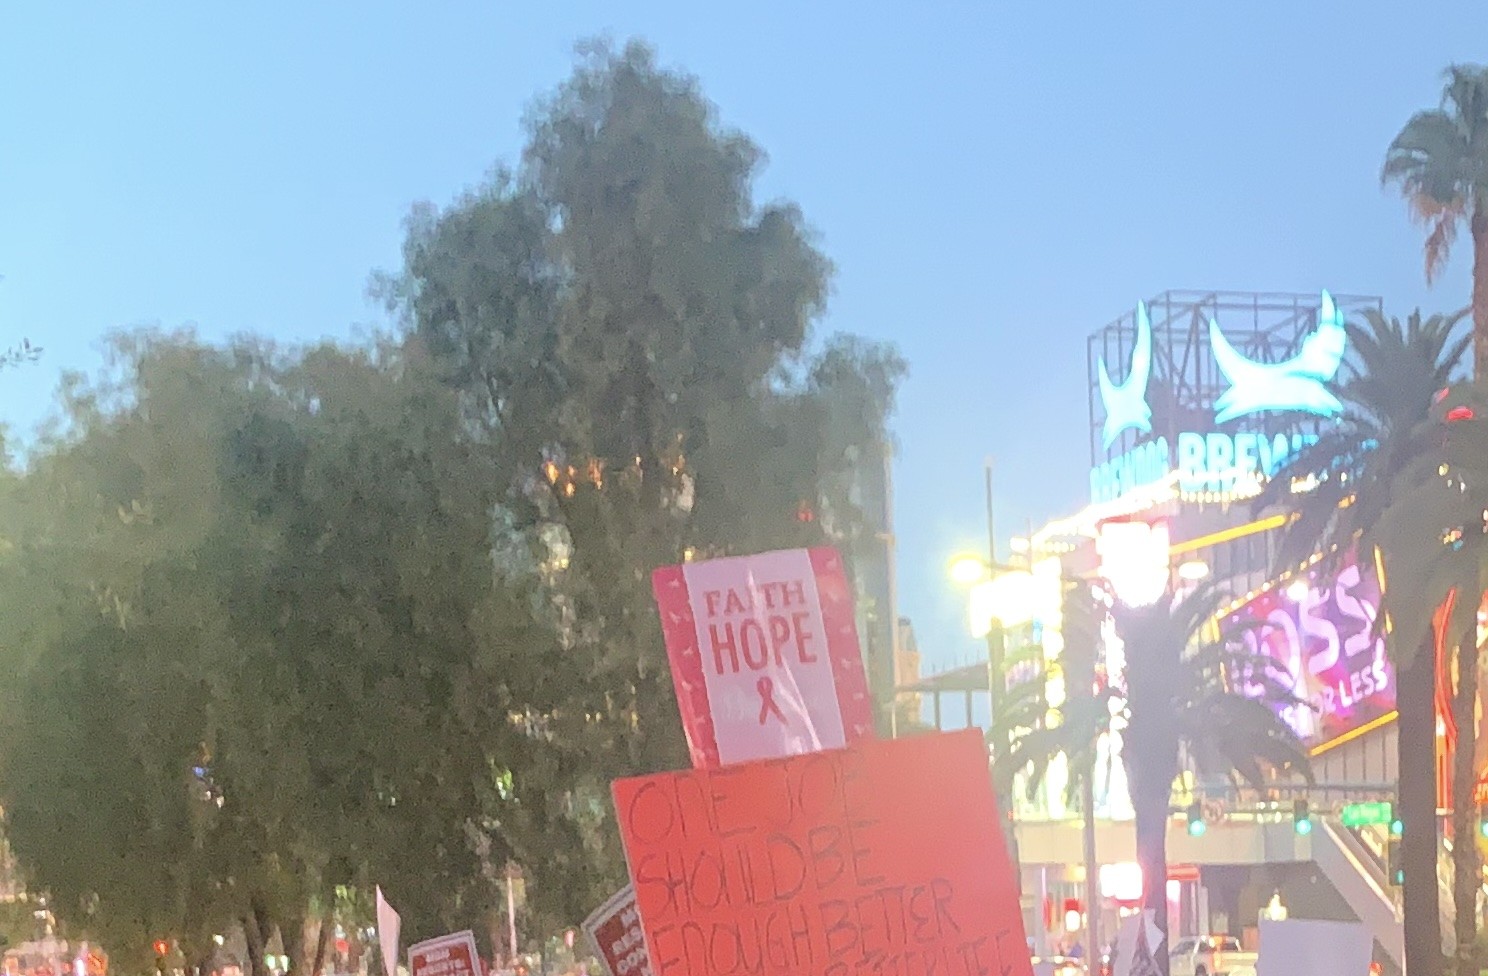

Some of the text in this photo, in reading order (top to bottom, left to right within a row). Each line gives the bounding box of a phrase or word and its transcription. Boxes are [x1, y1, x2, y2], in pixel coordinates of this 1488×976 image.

[702, 580, 805, 618] FAITH
[709, 611, 817, 675] HOPE
[628, 767, 757, 845] ONE
